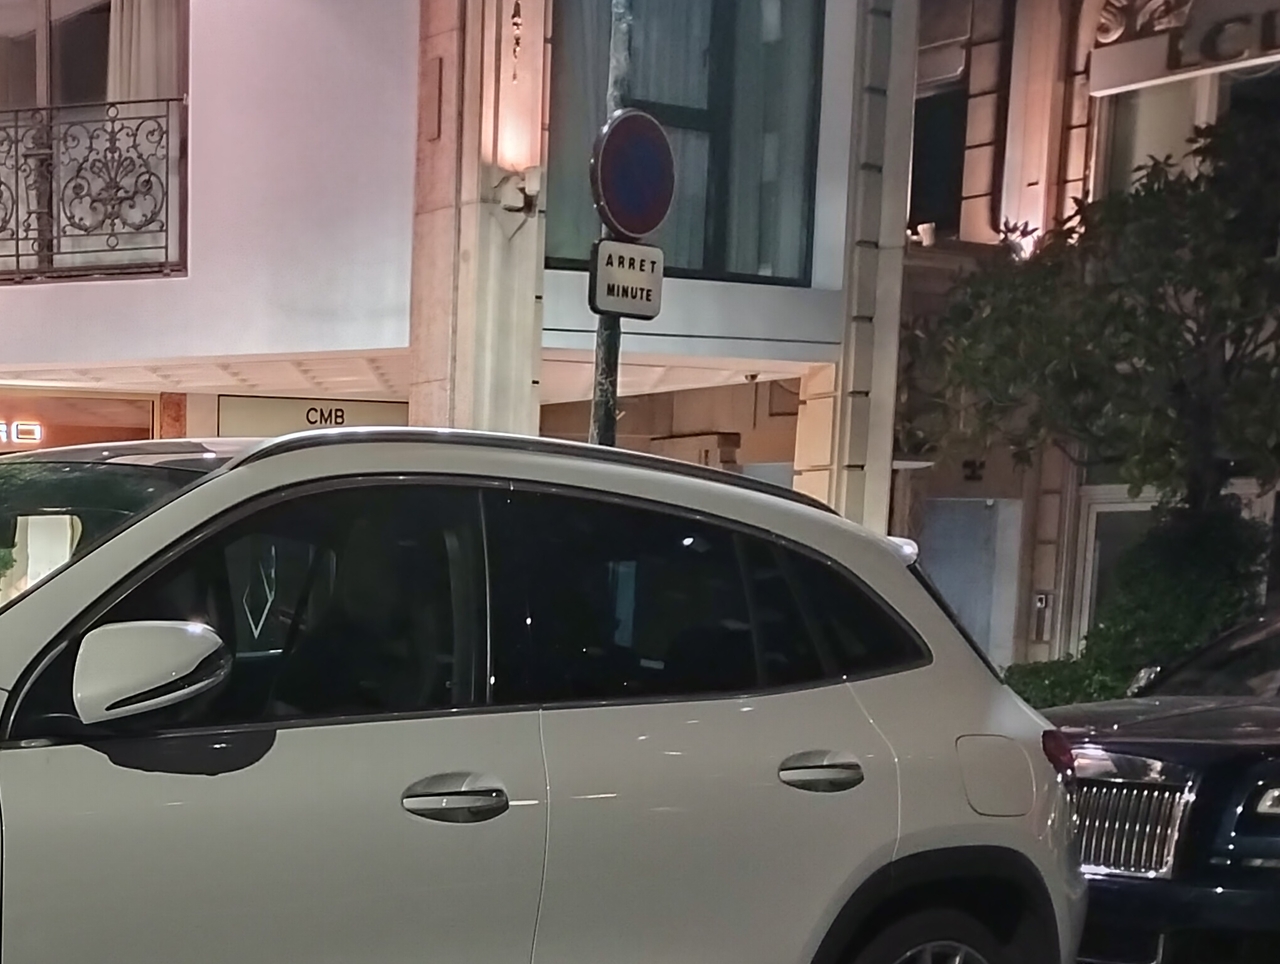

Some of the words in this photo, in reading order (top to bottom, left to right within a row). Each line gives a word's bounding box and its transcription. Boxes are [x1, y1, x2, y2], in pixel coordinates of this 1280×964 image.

[605, 253, 657, 274] ARRET
[606, 282, 653, 302] MINUTE
[306, 407, 346, 425] CMB
